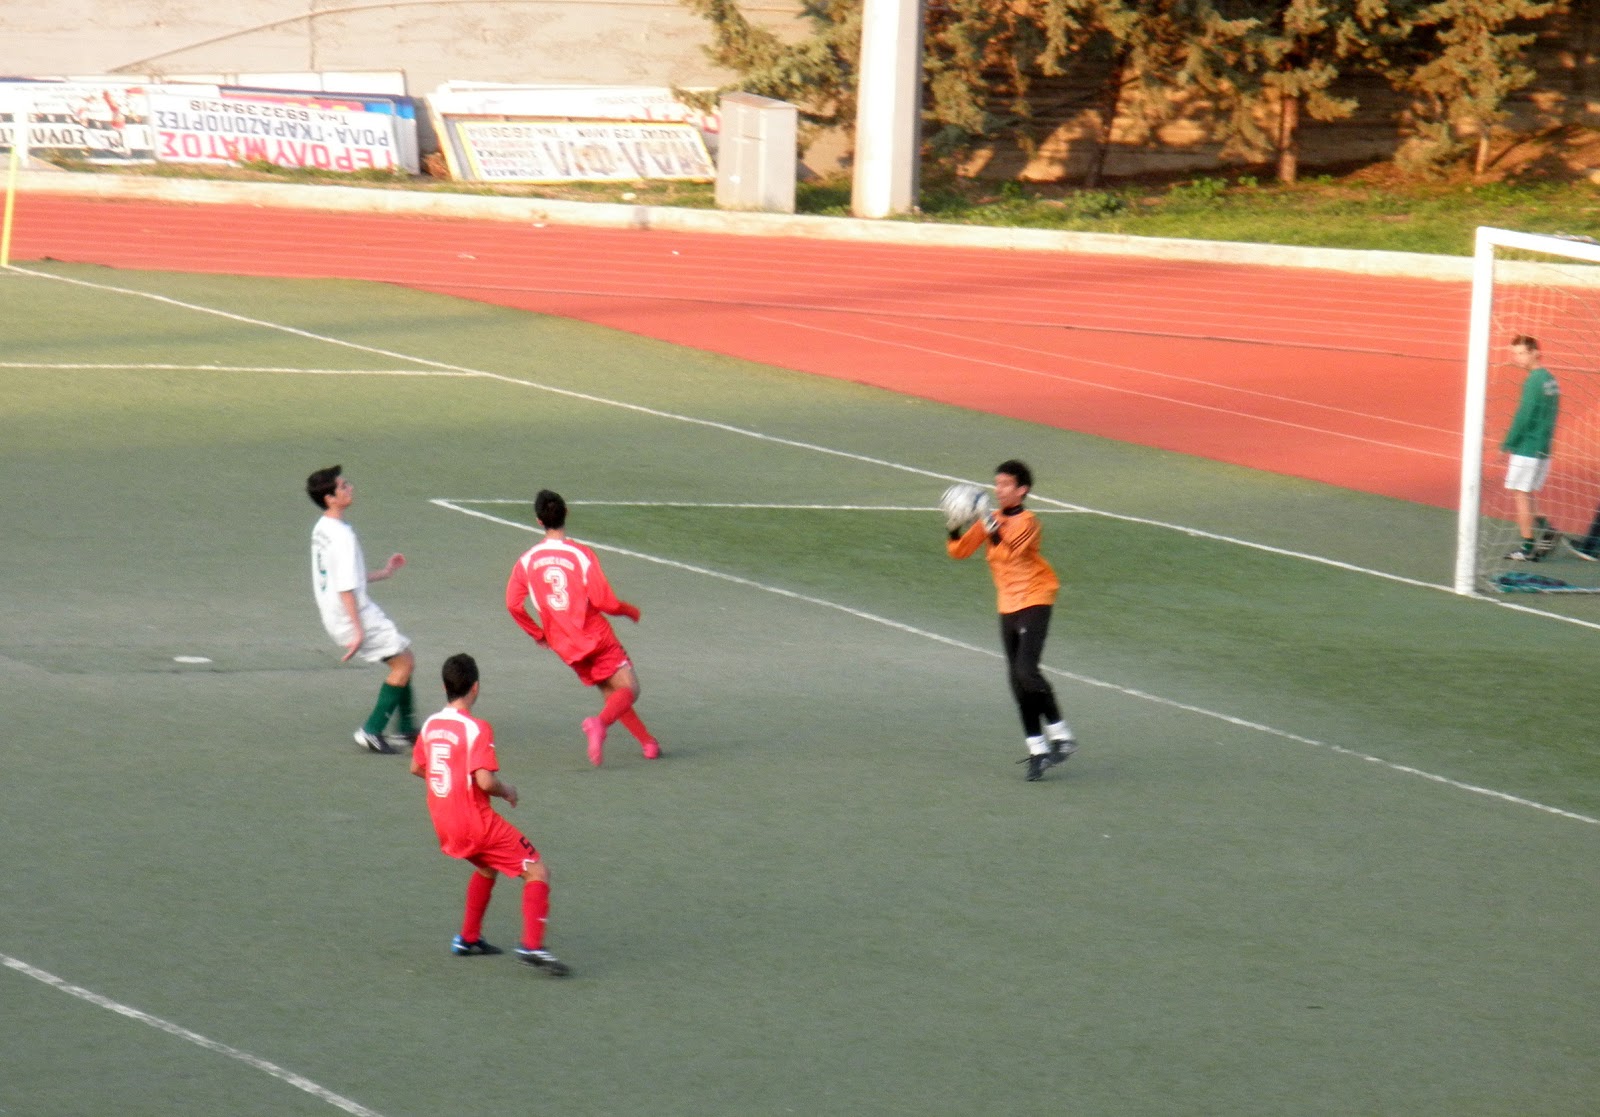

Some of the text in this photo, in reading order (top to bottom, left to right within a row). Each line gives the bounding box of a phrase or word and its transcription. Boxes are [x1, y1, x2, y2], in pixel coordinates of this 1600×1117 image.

[543, 566, 570, 611] 3
[429, 743, 452, 798] 5
[519, 836, 536, 855] 5
